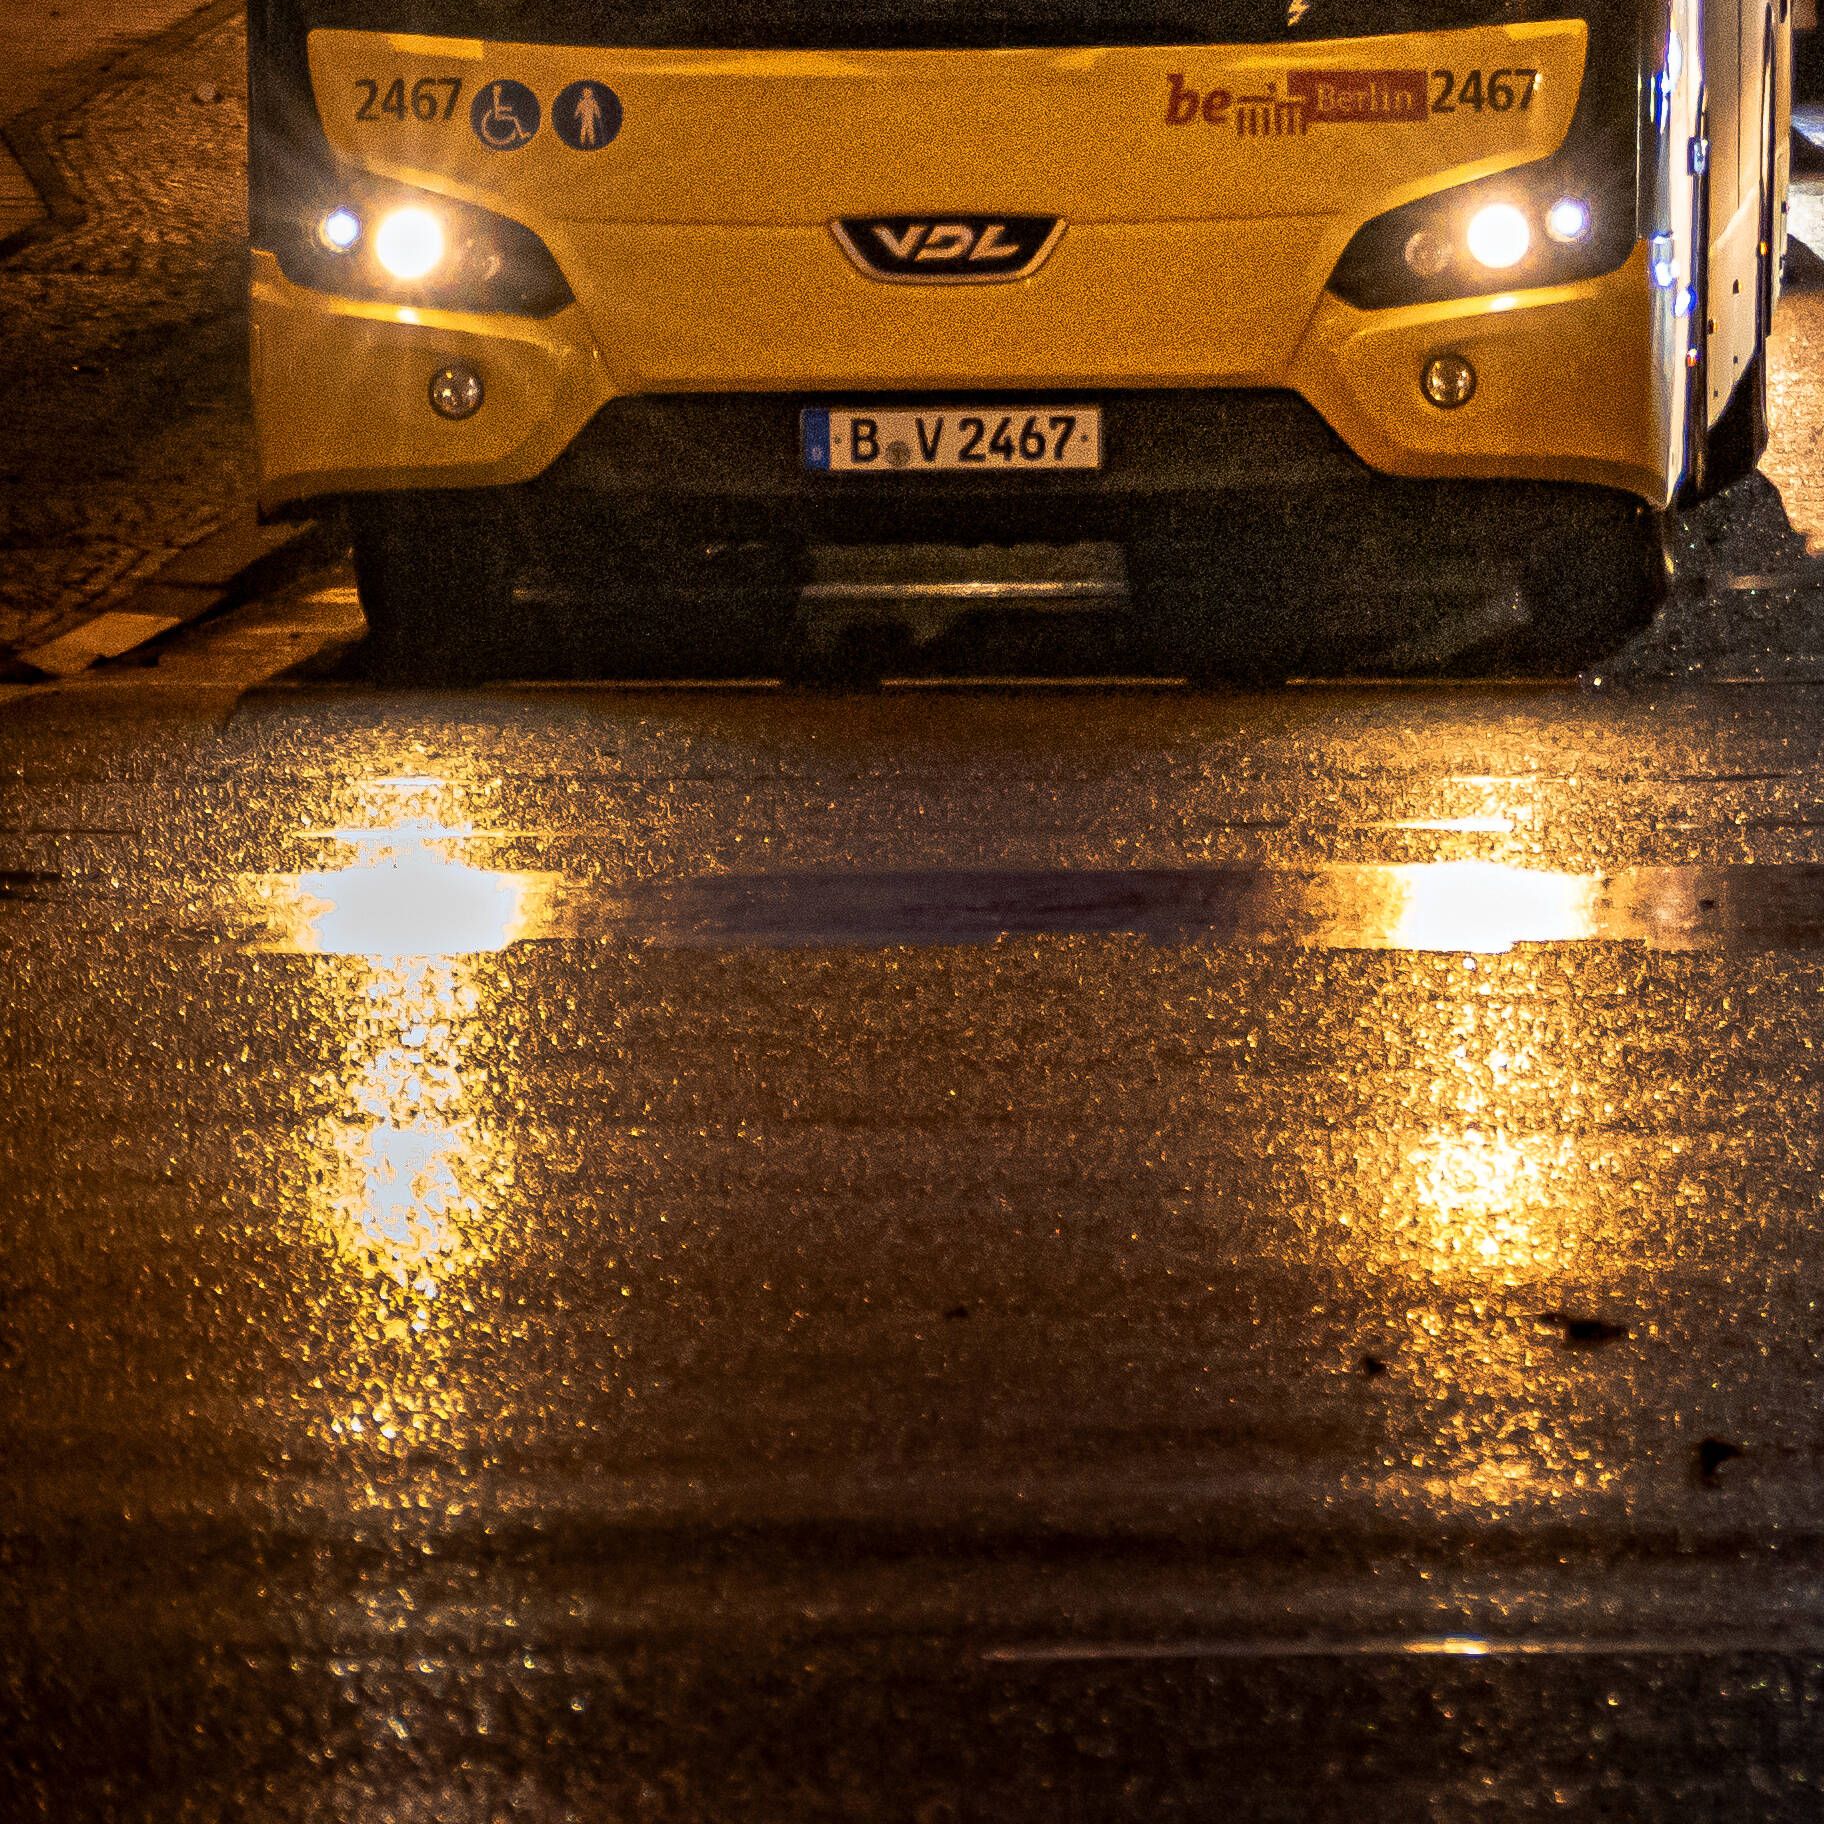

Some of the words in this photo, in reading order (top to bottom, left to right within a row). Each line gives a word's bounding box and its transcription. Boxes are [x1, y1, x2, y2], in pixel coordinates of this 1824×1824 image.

[354, 77, 463, 122] 2467
[1165, 73, 1232, 125] be
[1316, 81, 1415, 113] Berlin
[1431, 68, 1540, 115] 2467
[871, 224, 1021, 262] VDL
[850, 418, 880, 463] B
[915, 417, 945, 463] V
[957, 416, 1077, 463] 2467
